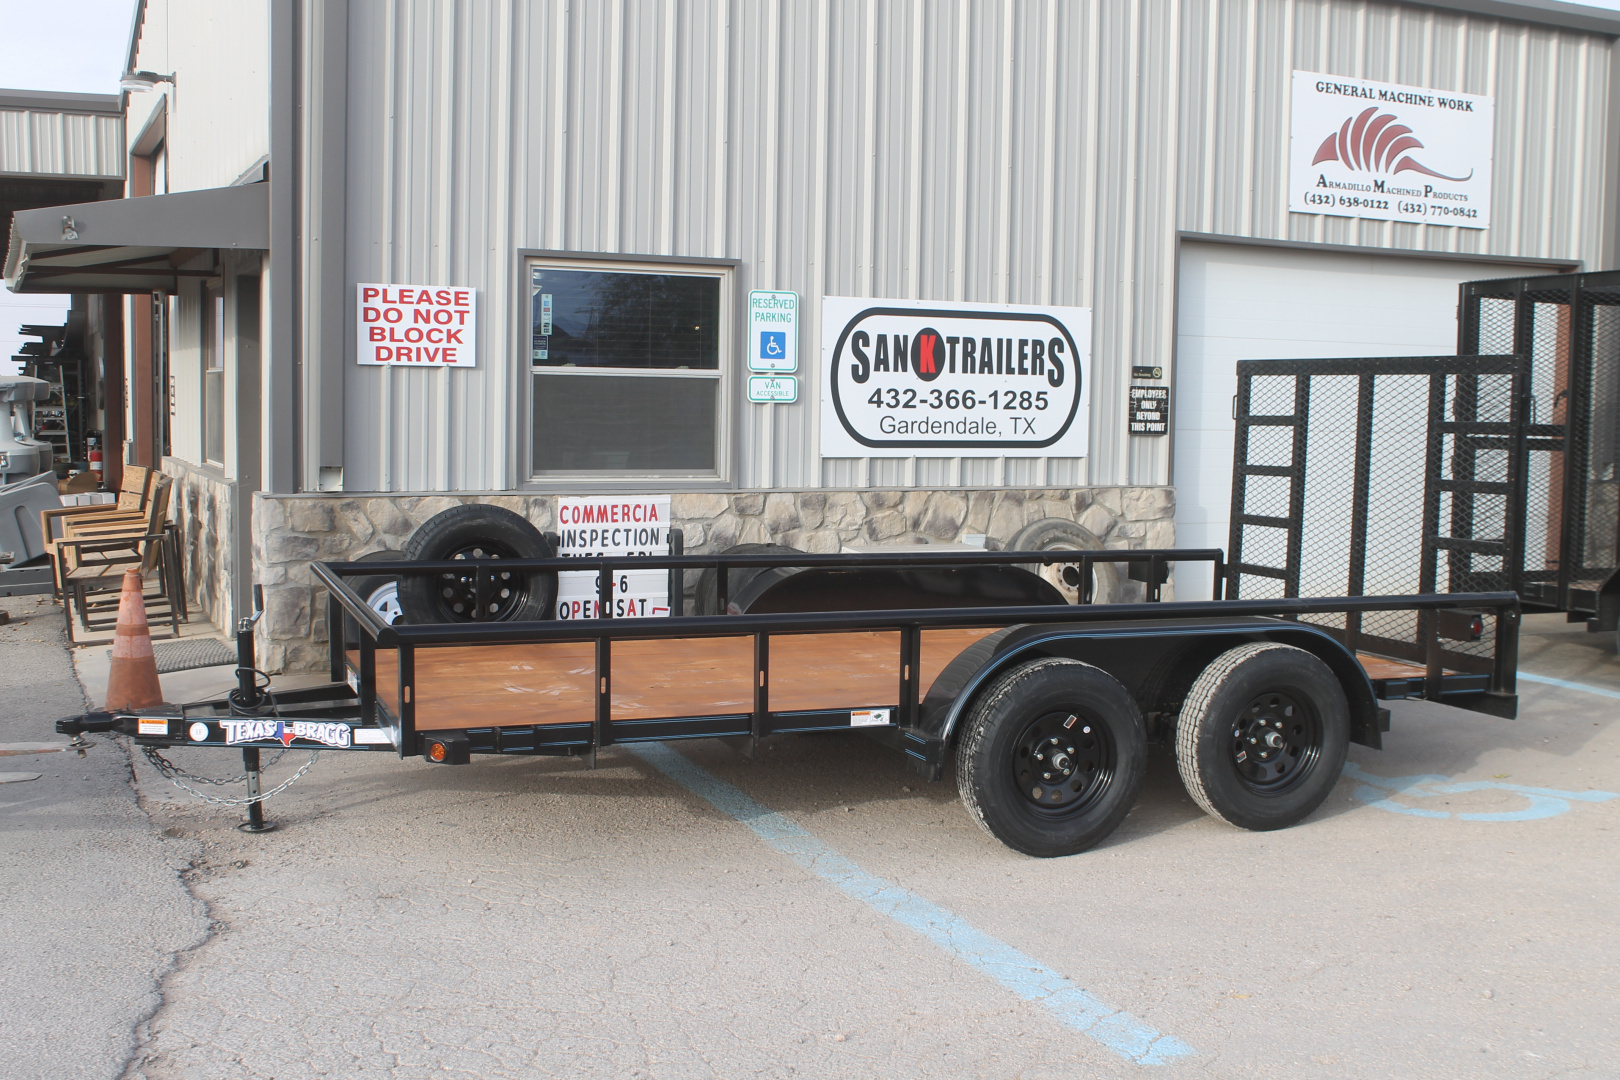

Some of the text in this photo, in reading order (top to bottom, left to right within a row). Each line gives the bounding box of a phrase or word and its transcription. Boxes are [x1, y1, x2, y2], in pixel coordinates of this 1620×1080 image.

[1316, 81, 1474, 112] GENERAL MACHINE WORK
[1316, 174, 1468, 201] ARMADILLO MACHINED PRODUCTS
[1304, 191, 1478, 218] (432) 638-0122 (432) 770-0842
[363, 287, 470, 307] PLEASE
[752, 298, 795, 310] RESERVED
[363, 307, 470, 325] DO NOT
[755, 312, 792, 323] PARKING
[369, 326, 464, 344] BLOCK
[375, 346, 457, 363] DRIVE
[765, 381, 781, 389] VAN
[1131, 388, 1167, 399] EMPLOYEES
[867, 388, 1049, 410] 432-366-1285
[1140, 400, 1157, 410] ONLY
[1136, 411, 1161, 421] BEYOND
[879, 415, 1036, 437] Gardendale, TX
[1131, 422, 1165, 432] THIS POINT
[560, 504, 658, 524] COMMERCIA
[561, 528, 660, 548] INSPECTION
[616, 599, 647, 617] SAT
[220, 720, 276, 745] TEXAS
[293, 721, 351, 747] BRAGG
